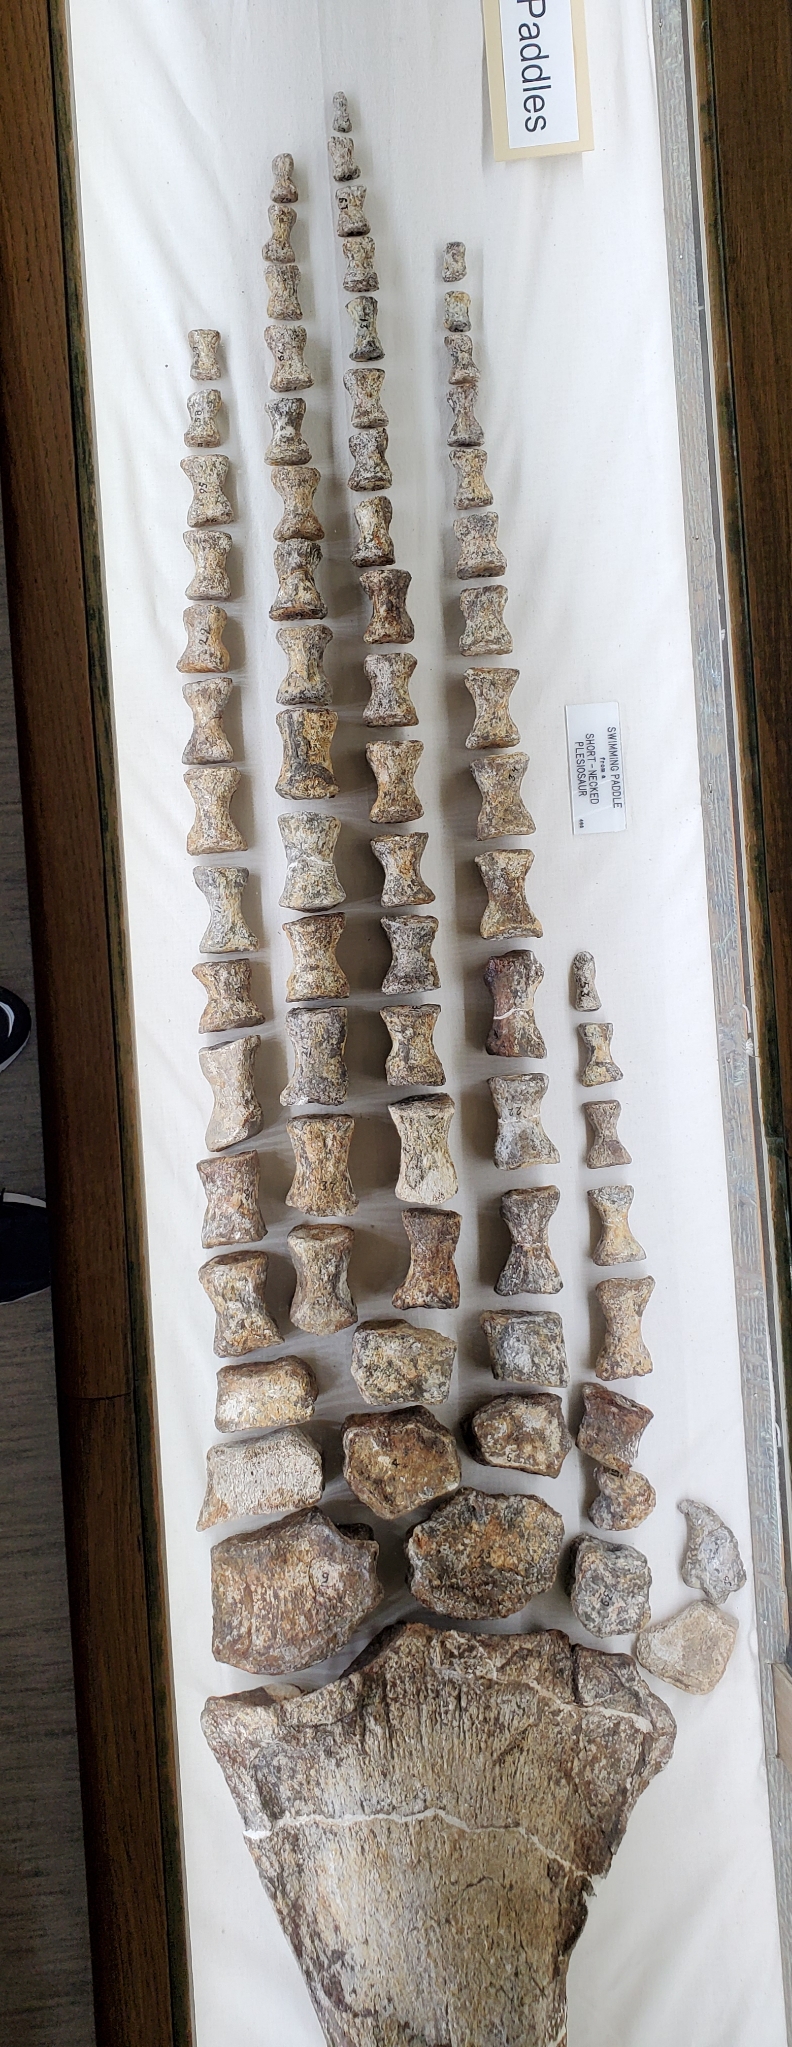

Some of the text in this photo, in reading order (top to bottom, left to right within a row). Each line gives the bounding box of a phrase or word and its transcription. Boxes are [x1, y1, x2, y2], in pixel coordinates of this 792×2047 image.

[516, 0, 552, 133] Paddles
[575, 741, 588, 797] PLESIOSAUR
[607, 726, 623, 809] SWIMMING PADDLE
[320, 1180, 336, 1192] 37
[391, 1458, 400, 1468] 4
[506, 1452, 512, 1462] 5
